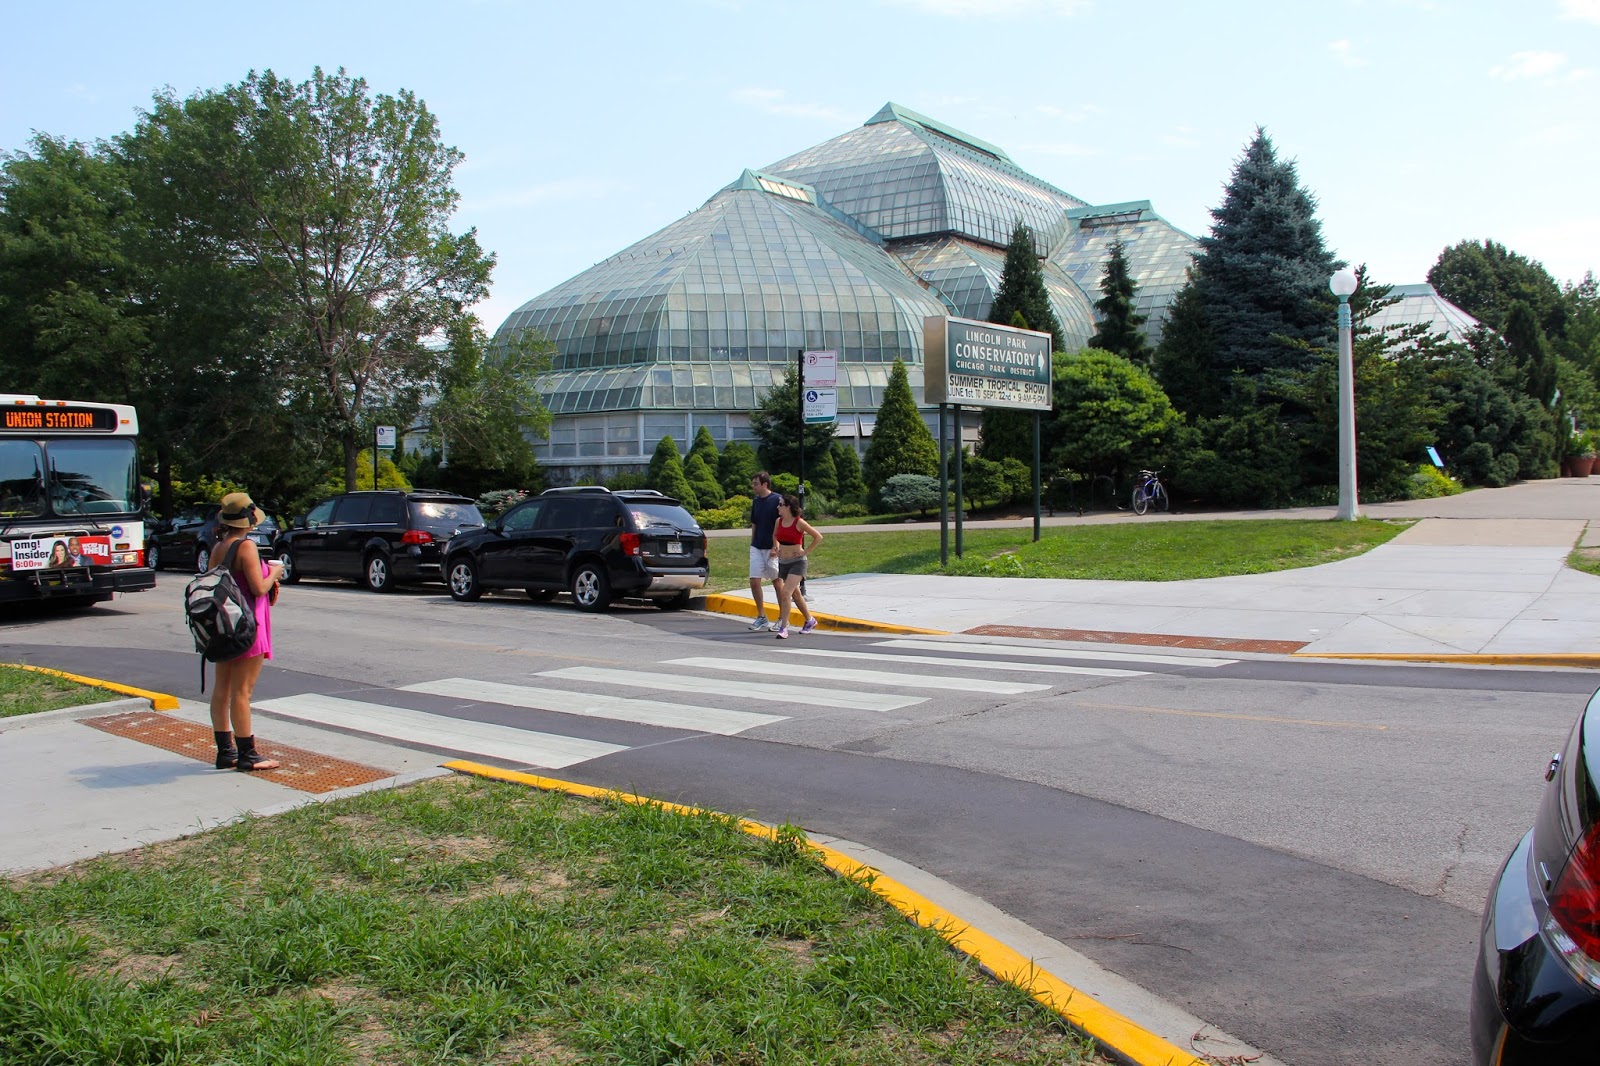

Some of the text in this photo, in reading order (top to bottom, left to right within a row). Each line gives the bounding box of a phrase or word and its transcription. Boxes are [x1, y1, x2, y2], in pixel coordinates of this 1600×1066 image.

[966, 330, 1027, 349] LINCOLN PARK
[956, 343, 1036, 367] CONSERVATORY
[956, 360, 1036, 377] CHICAGO PARK DISTRICT
[949, 375, 1046, 395] SUMMER TROPICAL SHOW
[949, 386, 964, 397] JUNE
[999, 391, 1011, 401] 22nd
[6, 412, 93, 428] UNION STATION
[14, 540, 41, 550] omg!
[15, 550, 50, 560] Insider
